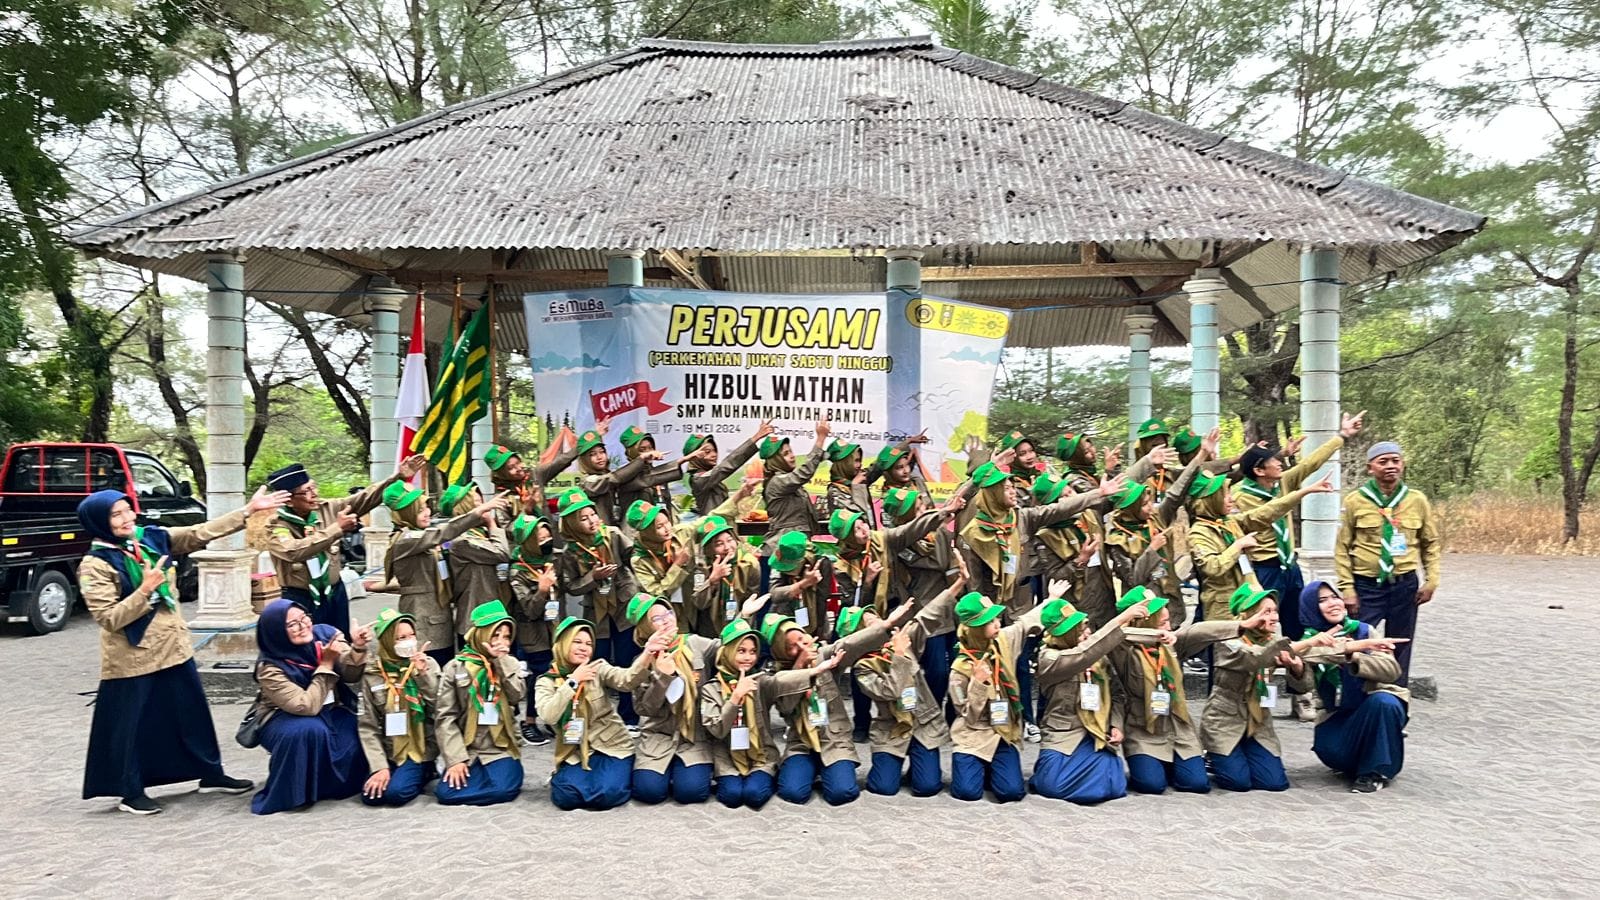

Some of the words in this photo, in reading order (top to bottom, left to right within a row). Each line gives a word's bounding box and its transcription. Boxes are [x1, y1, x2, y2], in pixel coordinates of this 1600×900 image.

[549, 298, 605, 314] EsMuBa
[666, 304, 881, 350] PERJUSAMI
[648, 350, 742, 367] (PERKEMAHAN
[746, 353, 787, 369] JUMAT
[791, 354, 834, 369] SABTU
[837, 356, 894, 373] MINGGU)
[684, 373, 762, 400] HIZBUL
[772, 375, 864, 404] WATHAN
[600, 387, 637, 413] CAMP
[676, 404, 705, 418] SMP
[711, 405, 820, 421] MUHAMMADIYAH
[827, 408, 872, 424] BANTUL
[662, 424, 673, 433] 17
[695, 424, 713, 433] MEI
[773, 426, 814, 439] Camping
